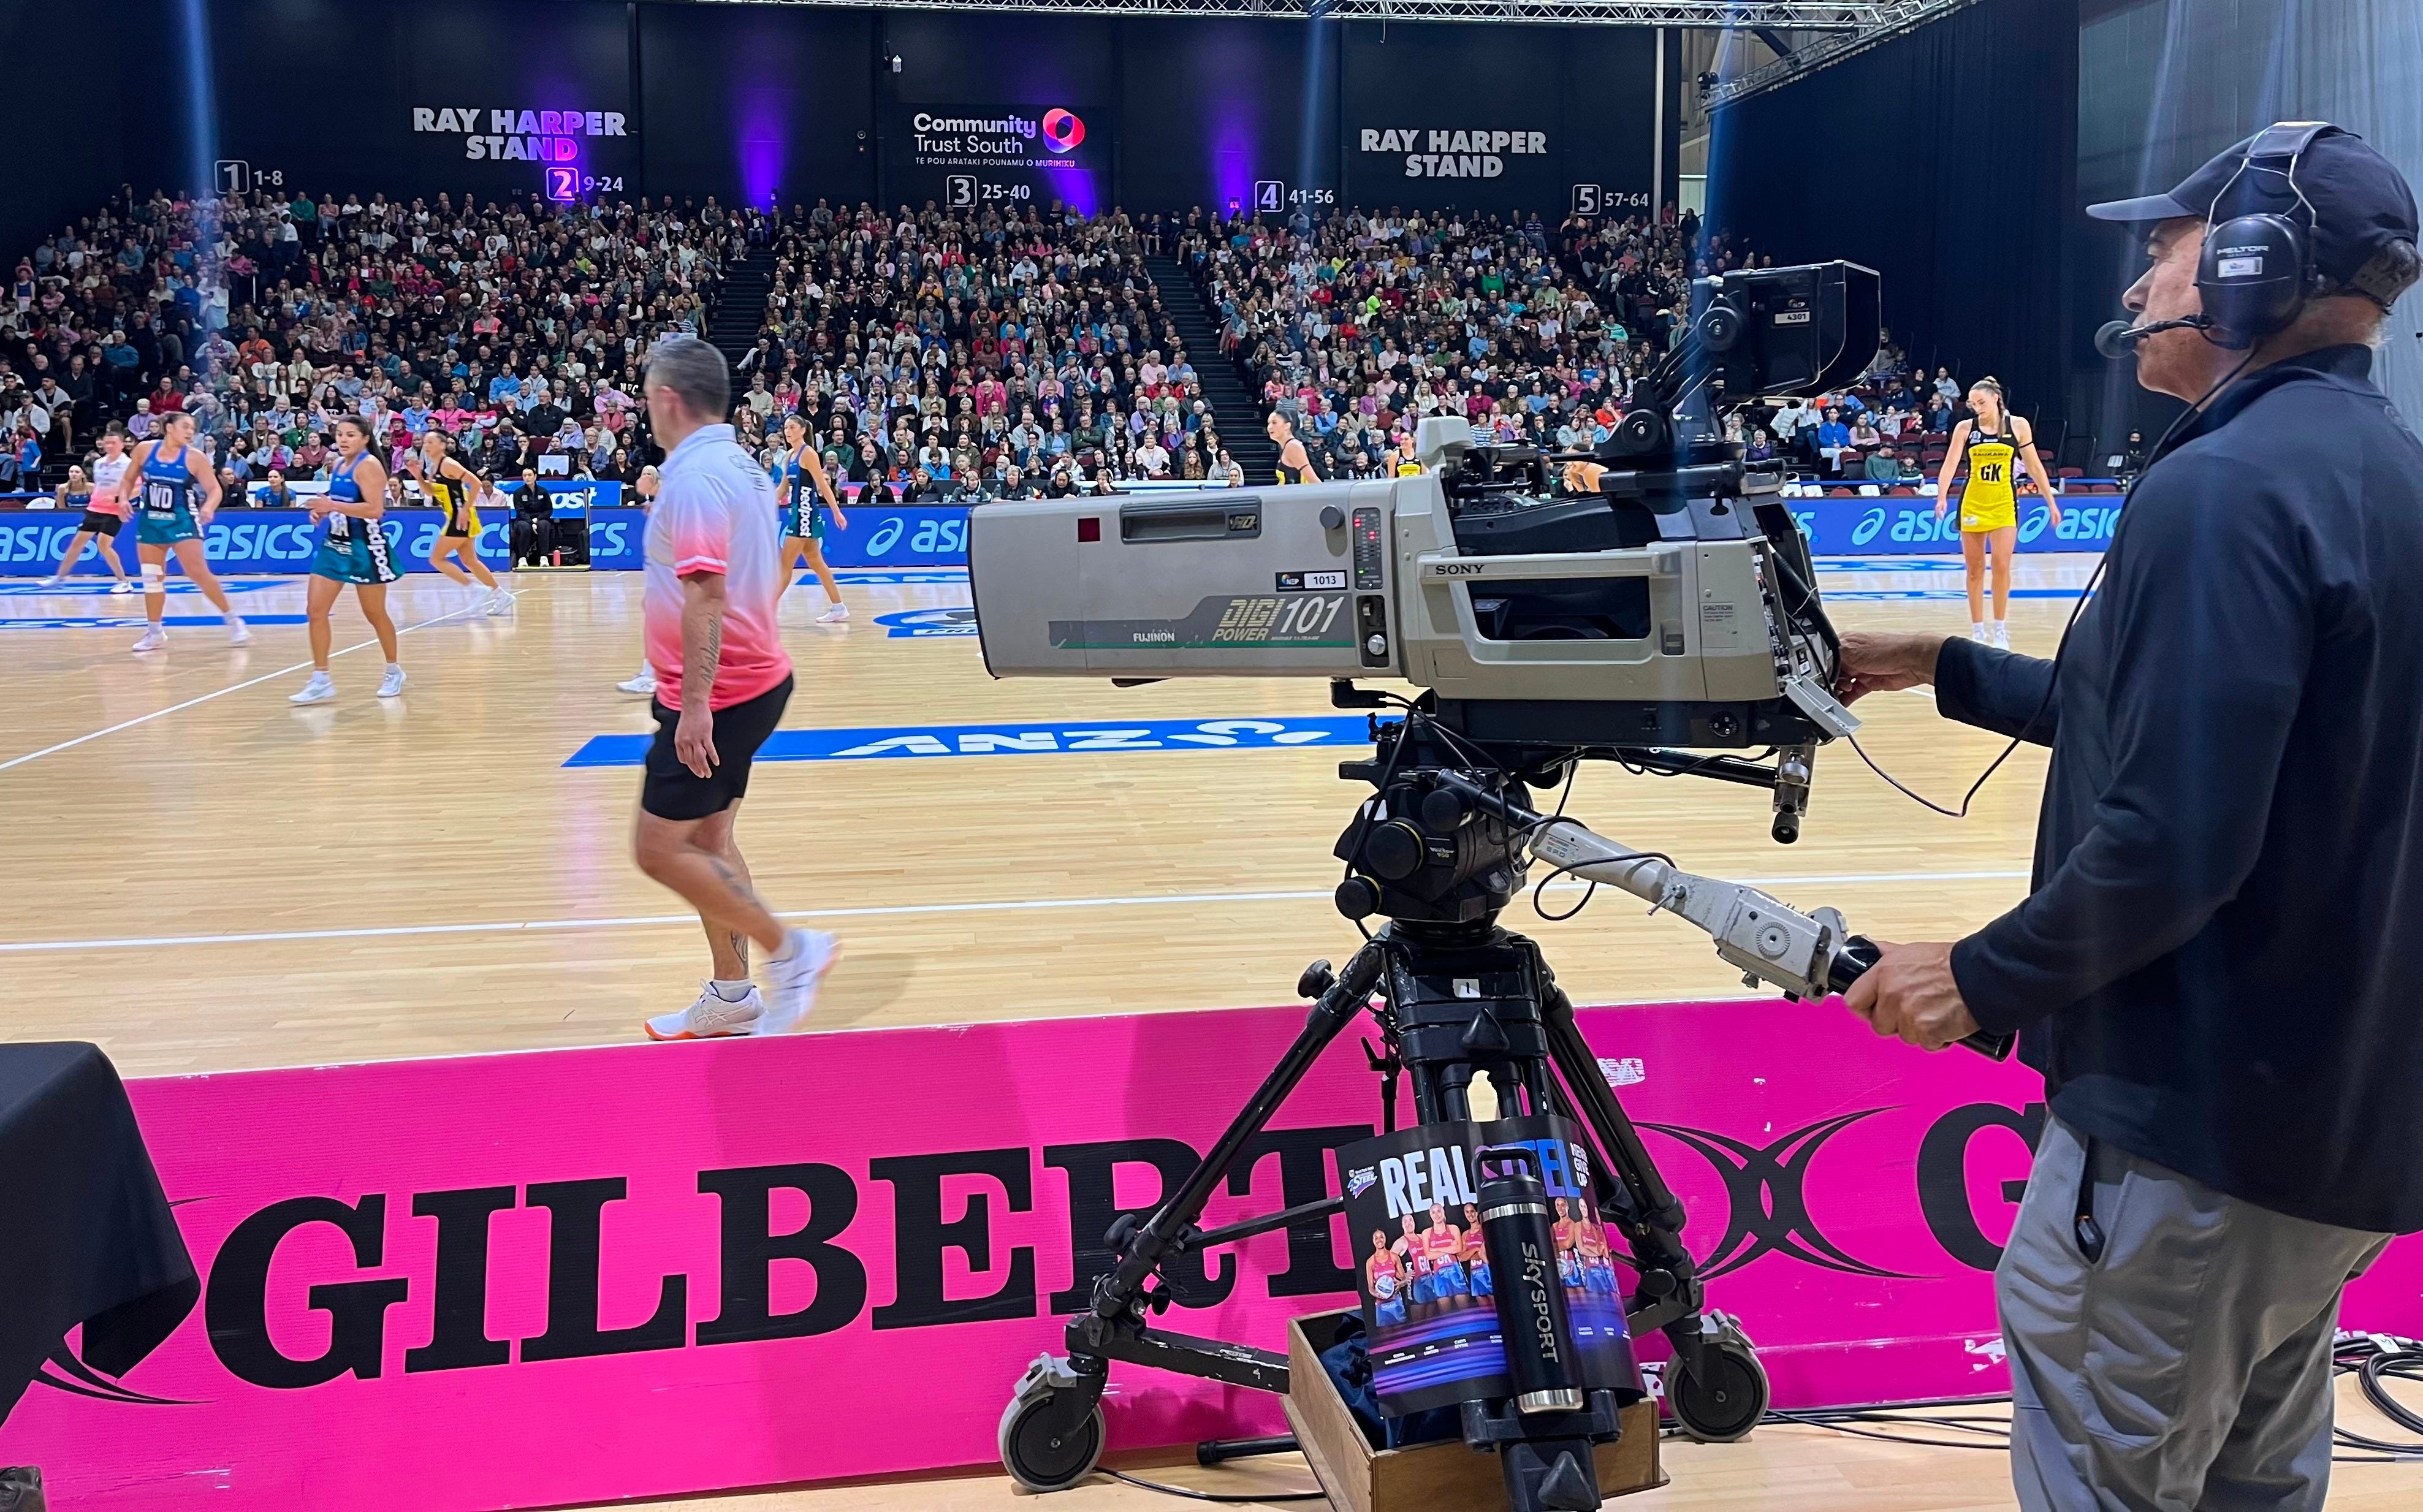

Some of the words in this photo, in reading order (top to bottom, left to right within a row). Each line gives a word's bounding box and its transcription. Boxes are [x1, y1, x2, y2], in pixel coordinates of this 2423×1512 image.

[413, 107, 481, 132] RAY
[492, 109, 627, 136] HARPER
[914, 113, 1036, 139] Community
[466, 136, 578, 161] STAND
[914, 134, 961, 153] Trust
[967, 135, 1024, 154] South
[1361, 129, 1420, 153] RAY
[1428, 130, 1547, 154] HARPER
[224, 164, 240, 192] 1
[254, 171, 283, 186] 1-8
[1405, 154, 1504, 178] STAND
[553, 171, 572, 198] 2
[584, 177, 623, 191] 9-24
[953, 178, 971, 203] 3
[982, 184, 1030, 200] 25-40
[1261, 184, 1278, 209] 4
[1289, 189, 1334, 203] 41-56
[1578, 188, 1595, 211] 5
[1605, 192, 1649, 207] 57-64
[2216, 246, 2269, 254] PELTOR
[1981, 463, 2003, 482] GK
[149, 485, 173, 509] WD
[798, 486, 813, 537] bedpost
[2055, 508, 2121, 539] asic
[911, 520, 968, 552] asi
[1890, 510, 1960, 541] asic
[363, 519, 397, 582] edpost
[1314, 576, 1336, 585] 1013
[1436, 564, 1485, 574] SONY
[1219, 598, 1286, 627] DIGI
[1280, 596, 1344, 633] 101
[1133, 633, 1175, 642] FUJINON
[1211, 628, 1269, 641] POWER
[829, 729, 1163, 756] ANZ
[1352, 1173, 1377, 1190] STEEL
[1380, 1145, 1478, 1219] REAL
[1577, 1171, 1588, 1187] UP
[206, 1124, 1375, 1388] GILBERT
[1531, 1289, 1559, 1363] SPORT
